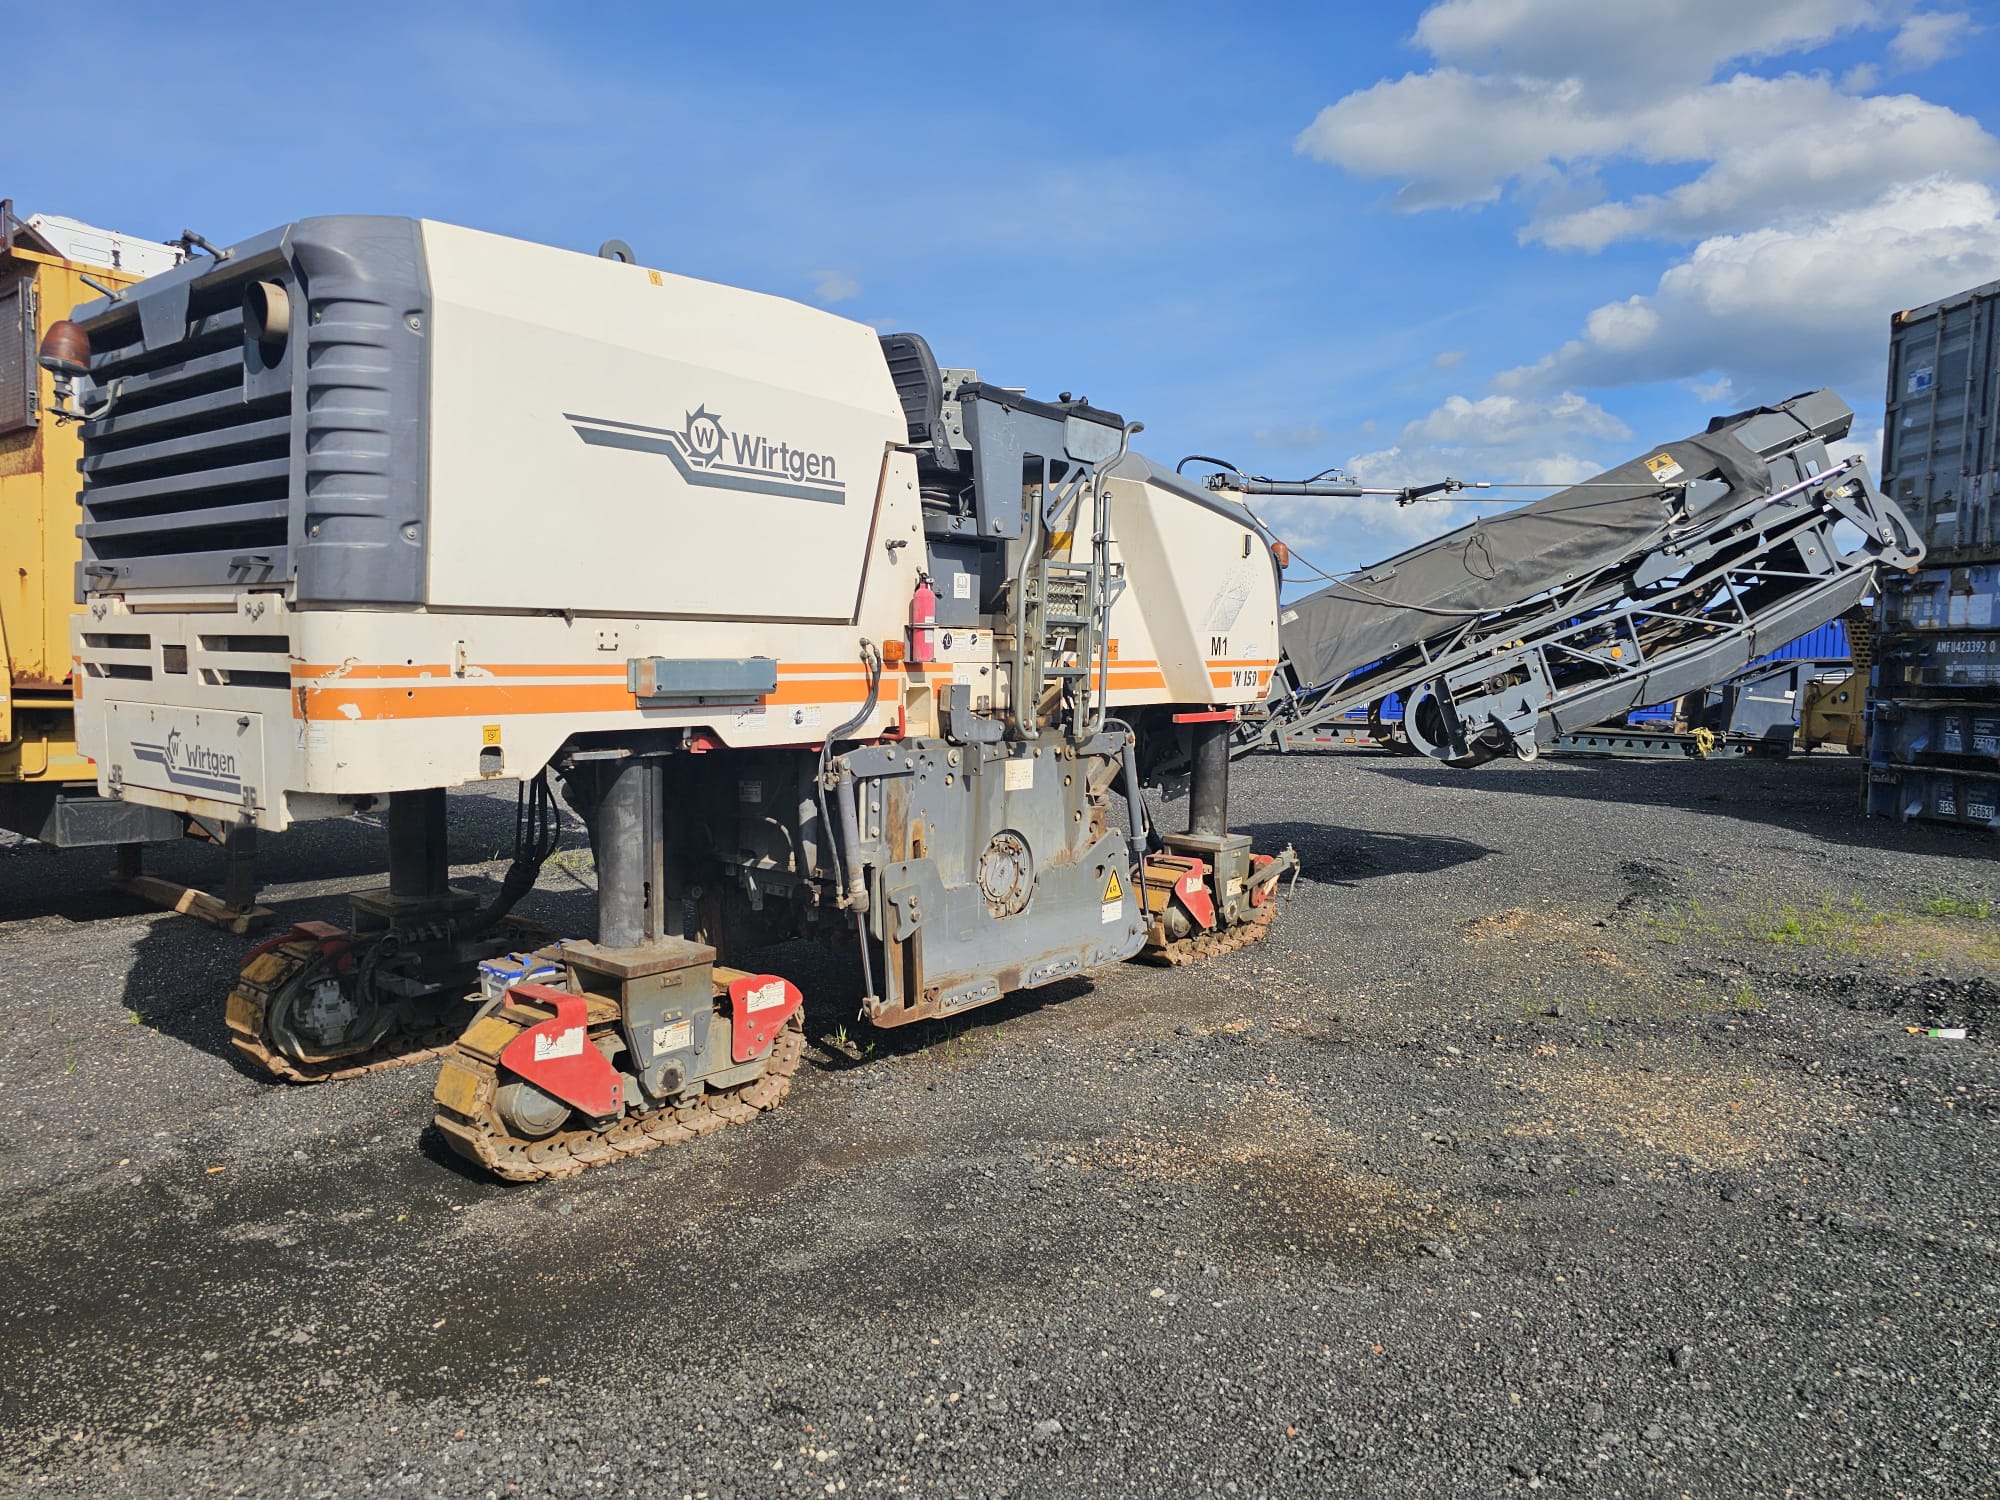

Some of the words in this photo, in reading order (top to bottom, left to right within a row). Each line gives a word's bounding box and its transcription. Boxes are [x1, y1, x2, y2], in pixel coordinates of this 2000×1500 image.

[695, 425, 714, 449] W
[731, 431, 836, 482] Wirtgen
[185, 743, 236, 777] Wirtgen
